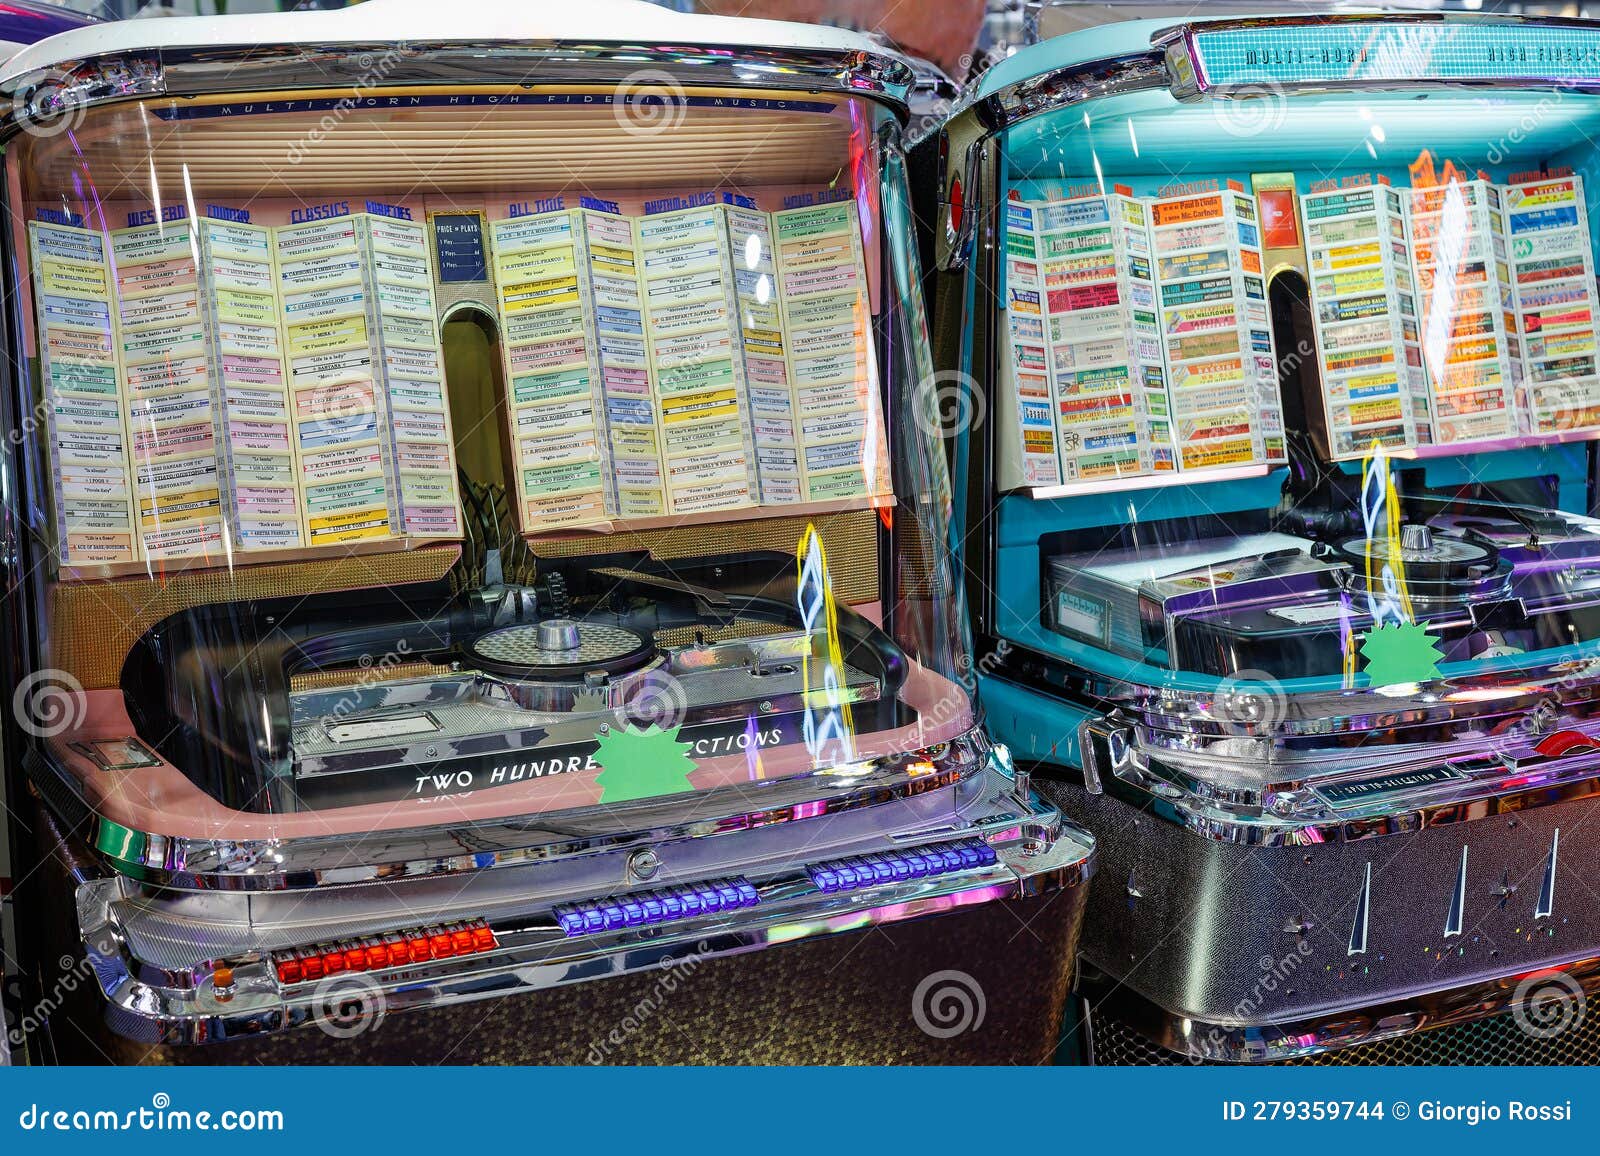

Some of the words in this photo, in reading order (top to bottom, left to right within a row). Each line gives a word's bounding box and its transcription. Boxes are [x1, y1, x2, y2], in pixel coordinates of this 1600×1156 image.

[1245, 48, 1368, 65] MULTI-HORN
[1488, 47, 1527, 62] HIGH
[221, 97, 420, 115] MULTI-HORN
[450, 95, 519, 104] HIGH
[547, 95, 690, 104] FIDELITY
[714, 98, 787, 108] MUSIC
[1157, 179, 1219, 200] FAVORITES
[290, 201, 350, 224] CLASSICS
[509, 202, 533, 218] ALL
[535, 197, 565, 213] TIME
[437, 225, 453, 234] PRICE
[460, 224, 479, 233] PLAYS
[1100, 458, 1136, 469] SPRINSTEEN
[414, 770, 474, 793] TWO
[488, 754, 597, 785] HUNDRE
[683, 727, 783, 757] CTIONS
[1345, 782, 1368, 794] SPIN
[1387, 773, 1438, 787] SELECTION
